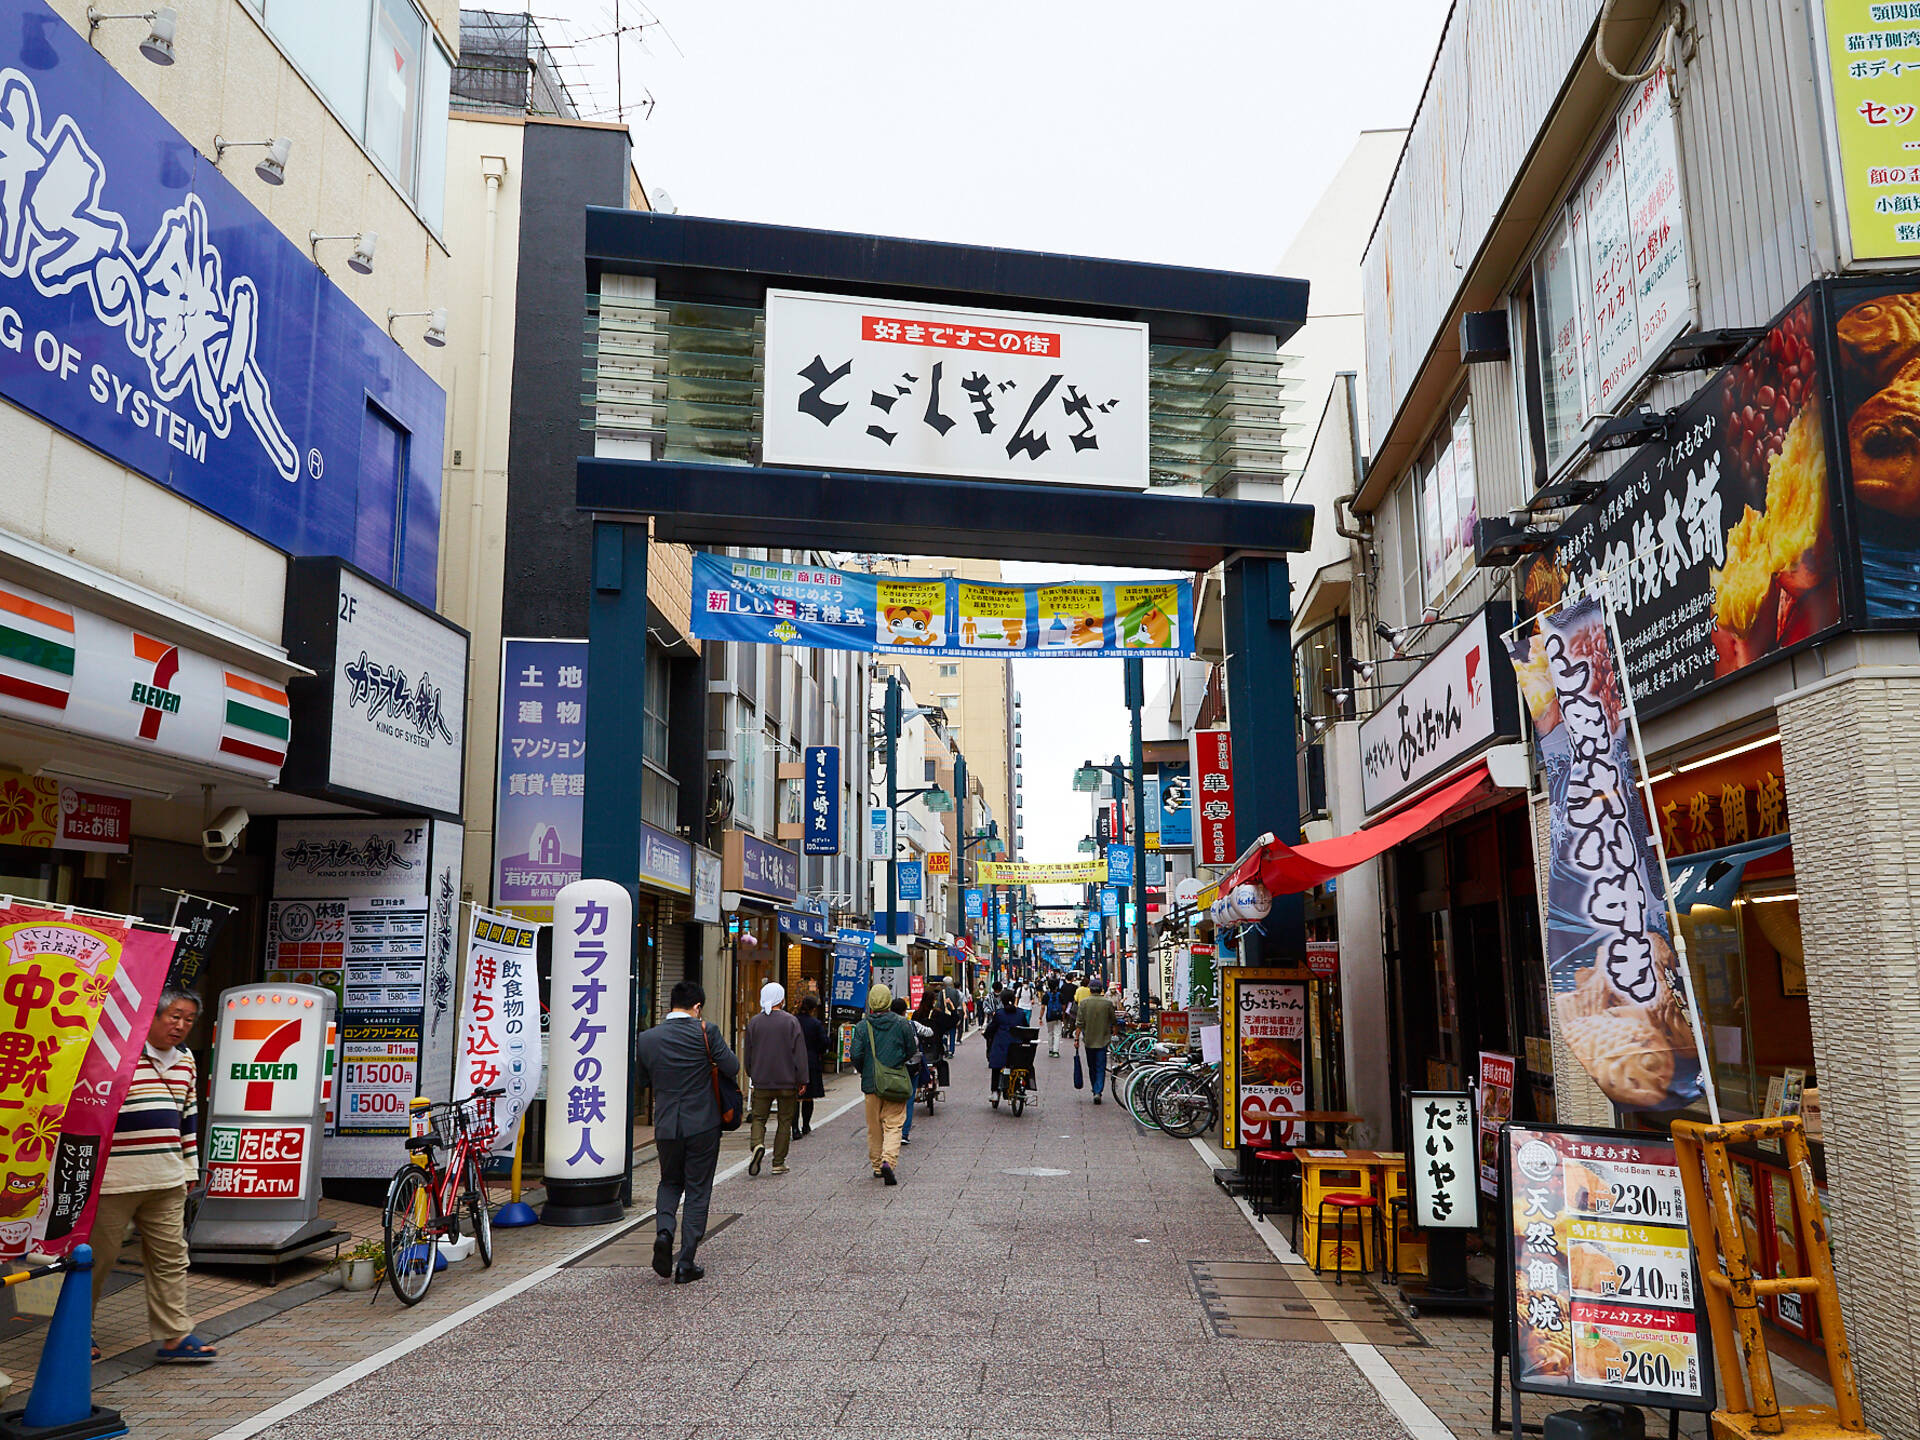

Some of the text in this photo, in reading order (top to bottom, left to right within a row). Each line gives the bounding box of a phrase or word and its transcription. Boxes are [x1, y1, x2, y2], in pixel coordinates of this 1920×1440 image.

[873, 319, 1050, 354] 好きですこの街
[34, 329, 82, 379] OF
[88, 364, 207, 464] SYSTEM
[797, 354, 1120, 461] とごしぎんざ
[732, 563, 842, 586] 戸越銀座商店街
[730, 579, 844, 602] みんなではじめよう
[340, 592, 358, 624] 2F
[707, 590, 865, 624] 新しい生活様式
[768, 631, 803, 640] CORONA
[775, 624, 796, 632] WITH
[519, 665, 583, 689] 土地
[131, 681, 181, 714] ELEVEN
[344, 650, 454, 746] カラオケの鉄人
[518, 701, 581, 724] 建物
[376, 720, 394, 737] KING
[405, 732, 430, 749] SYSTEM
[511, 738, 586, 759] マンション
[813, 749, 830, 831] すし三崎丸
[68, 817, 120, 837] 買うとお得!
[1662, 772, 1789, 856] 天然鯛焼
[282, 828, 423, 873] カラオケの鉄人 2F
[929, 855, 949, 864] ABC
[316, 902, 345, 918] 休憩
[315, 919, 344, 929] ランチ
[475, 920, 535, 948] 期間限定
[501, 960, 524, 1034] 飲食物の
[344, 1028, 418, 1039] ロングフリータイム
[565, 900, 609, 1166] カラオケの鉄人
[230, 1063, 298, 1080] ELEVEN
[359, 1093, 405, 1113] 500円
[1456, 1101, 1468, 1126] 天然
[211, 1128, 300, 1160] 酒 たばこ
[1568, 1144, 1641, 1161] 十勝産あずき
[1424, 1101, 1456, 1221] たいやき
[1613, 1165, 1629, 1174] Red
[1631, 1166, 1651, 1175] Bean
[210, 1167, 294, 1194] 銀行ATM
[1611, 1183, 1672, 1217] 230円
[1572, 1224, 1649, 1241] 鳴門金時いも
[1525, 1187, 1563, 1332] 天然鯛焼
[1631, 1246, 1657, 1257] Potato
[1616, 1264, 1678, 1301] 240円
[1576, 1307, 1676, 1327] プレミアムカスタード
[1601, 1327, 1634, 1339] Premium
[1635, 1330, 1665, 1341] Custard
[1622, 1351, 1685, 1389] 260円
